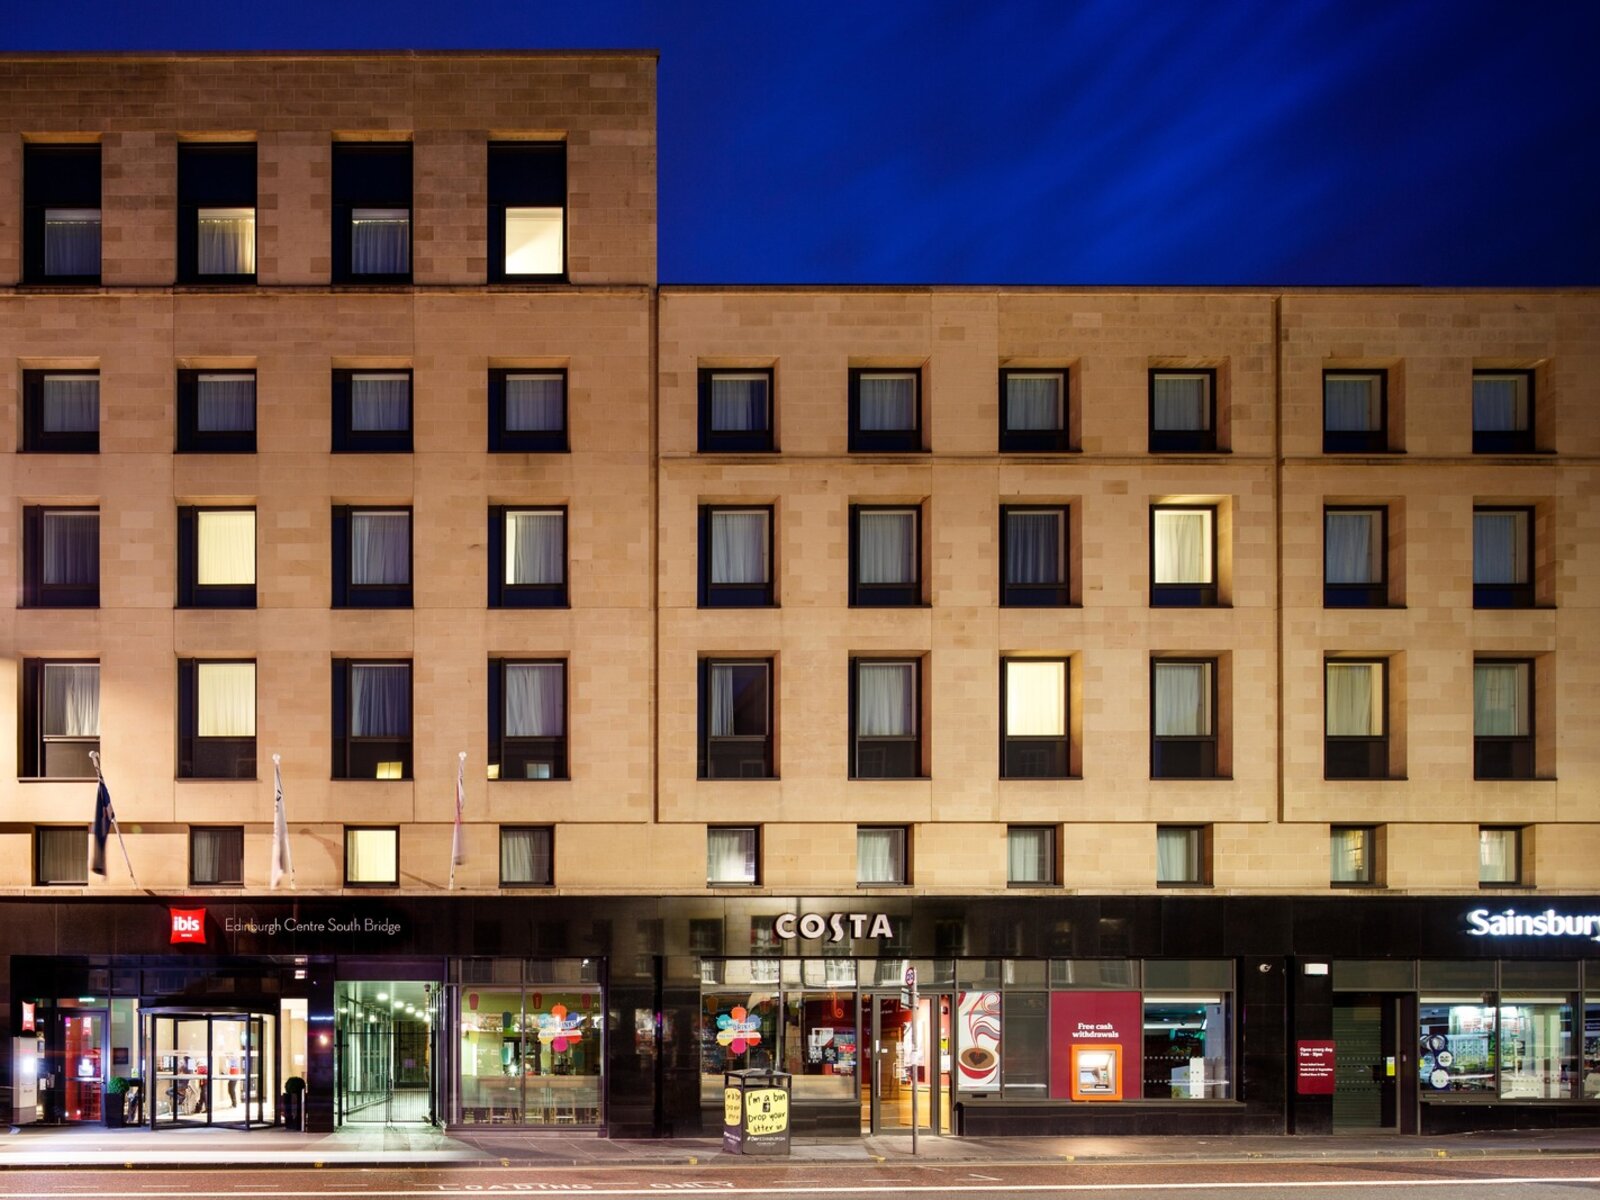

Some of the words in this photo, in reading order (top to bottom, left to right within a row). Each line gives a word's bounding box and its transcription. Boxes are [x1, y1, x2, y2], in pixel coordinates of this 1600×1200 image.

[173, 916, 200, 931] ibis
[225, 918, 282, 935] Edinburgh
[283, 917, 325, 931] Centre
[327, 917, 361, 931] South
[364, 917, 401, 935] Bridge
[773, 913, 893, 942] COSTA
[1077, 1022, 1095, 1030] Free
[1095, 1022, 1114, 1030] cash
[1072, 1030, 1120, 1038] withdrawals
[748, 1093, 760, 1105] I'm
[773, 1093, 786, 1102] bin
[748, 1114, 767, 1122] Drop
[769, 1112, 786, 1121] your
[650, 1180, 736, 1189] ONLY
